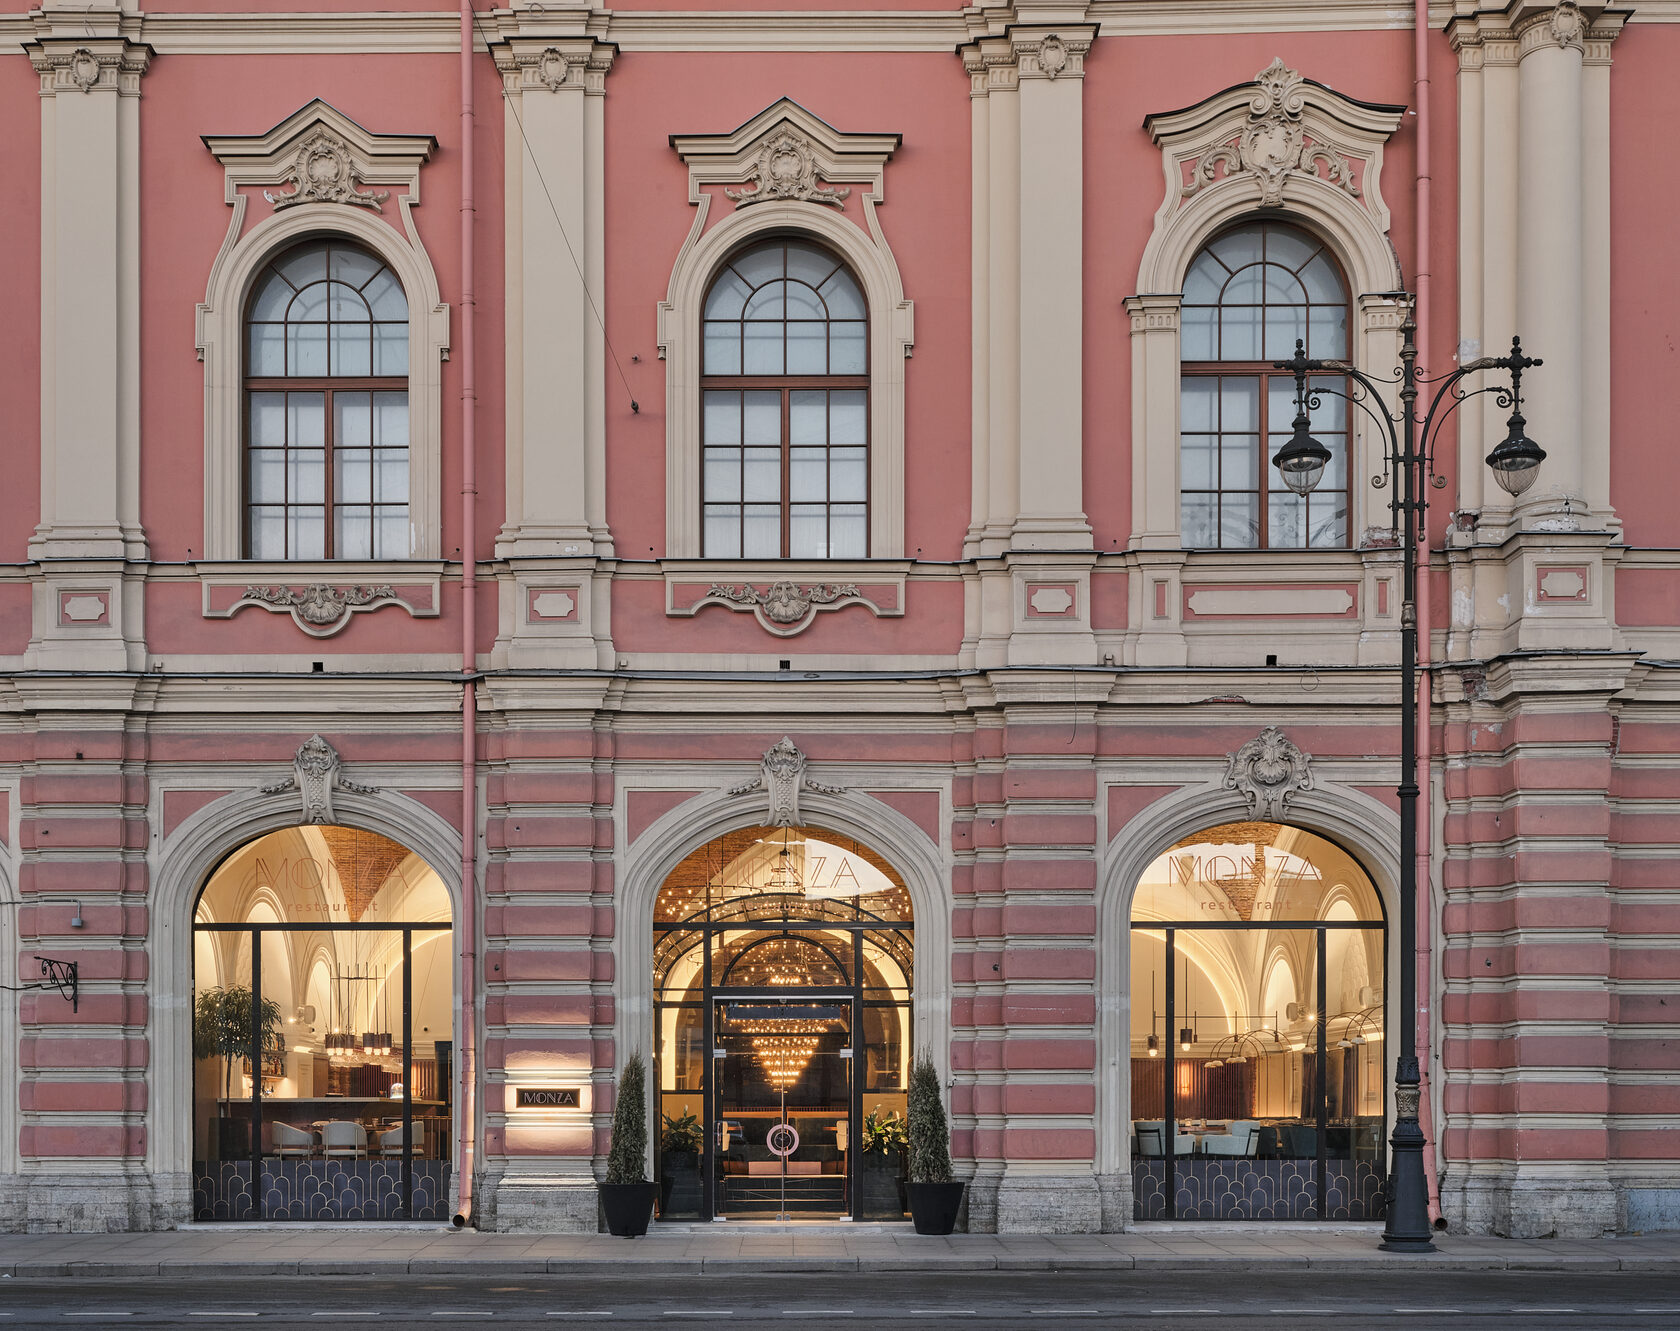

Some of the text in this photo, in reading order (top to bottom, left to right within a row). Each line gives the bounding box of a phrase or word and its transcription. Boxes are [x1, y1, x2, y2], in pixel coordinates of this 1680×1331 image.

[1168, 855, 1323, 888] MONZA
[287, 900, 378, 912] restaurt
[1201, 899, 1292, 910] restrant
[524, 1092, 574, 1104] MONZA
